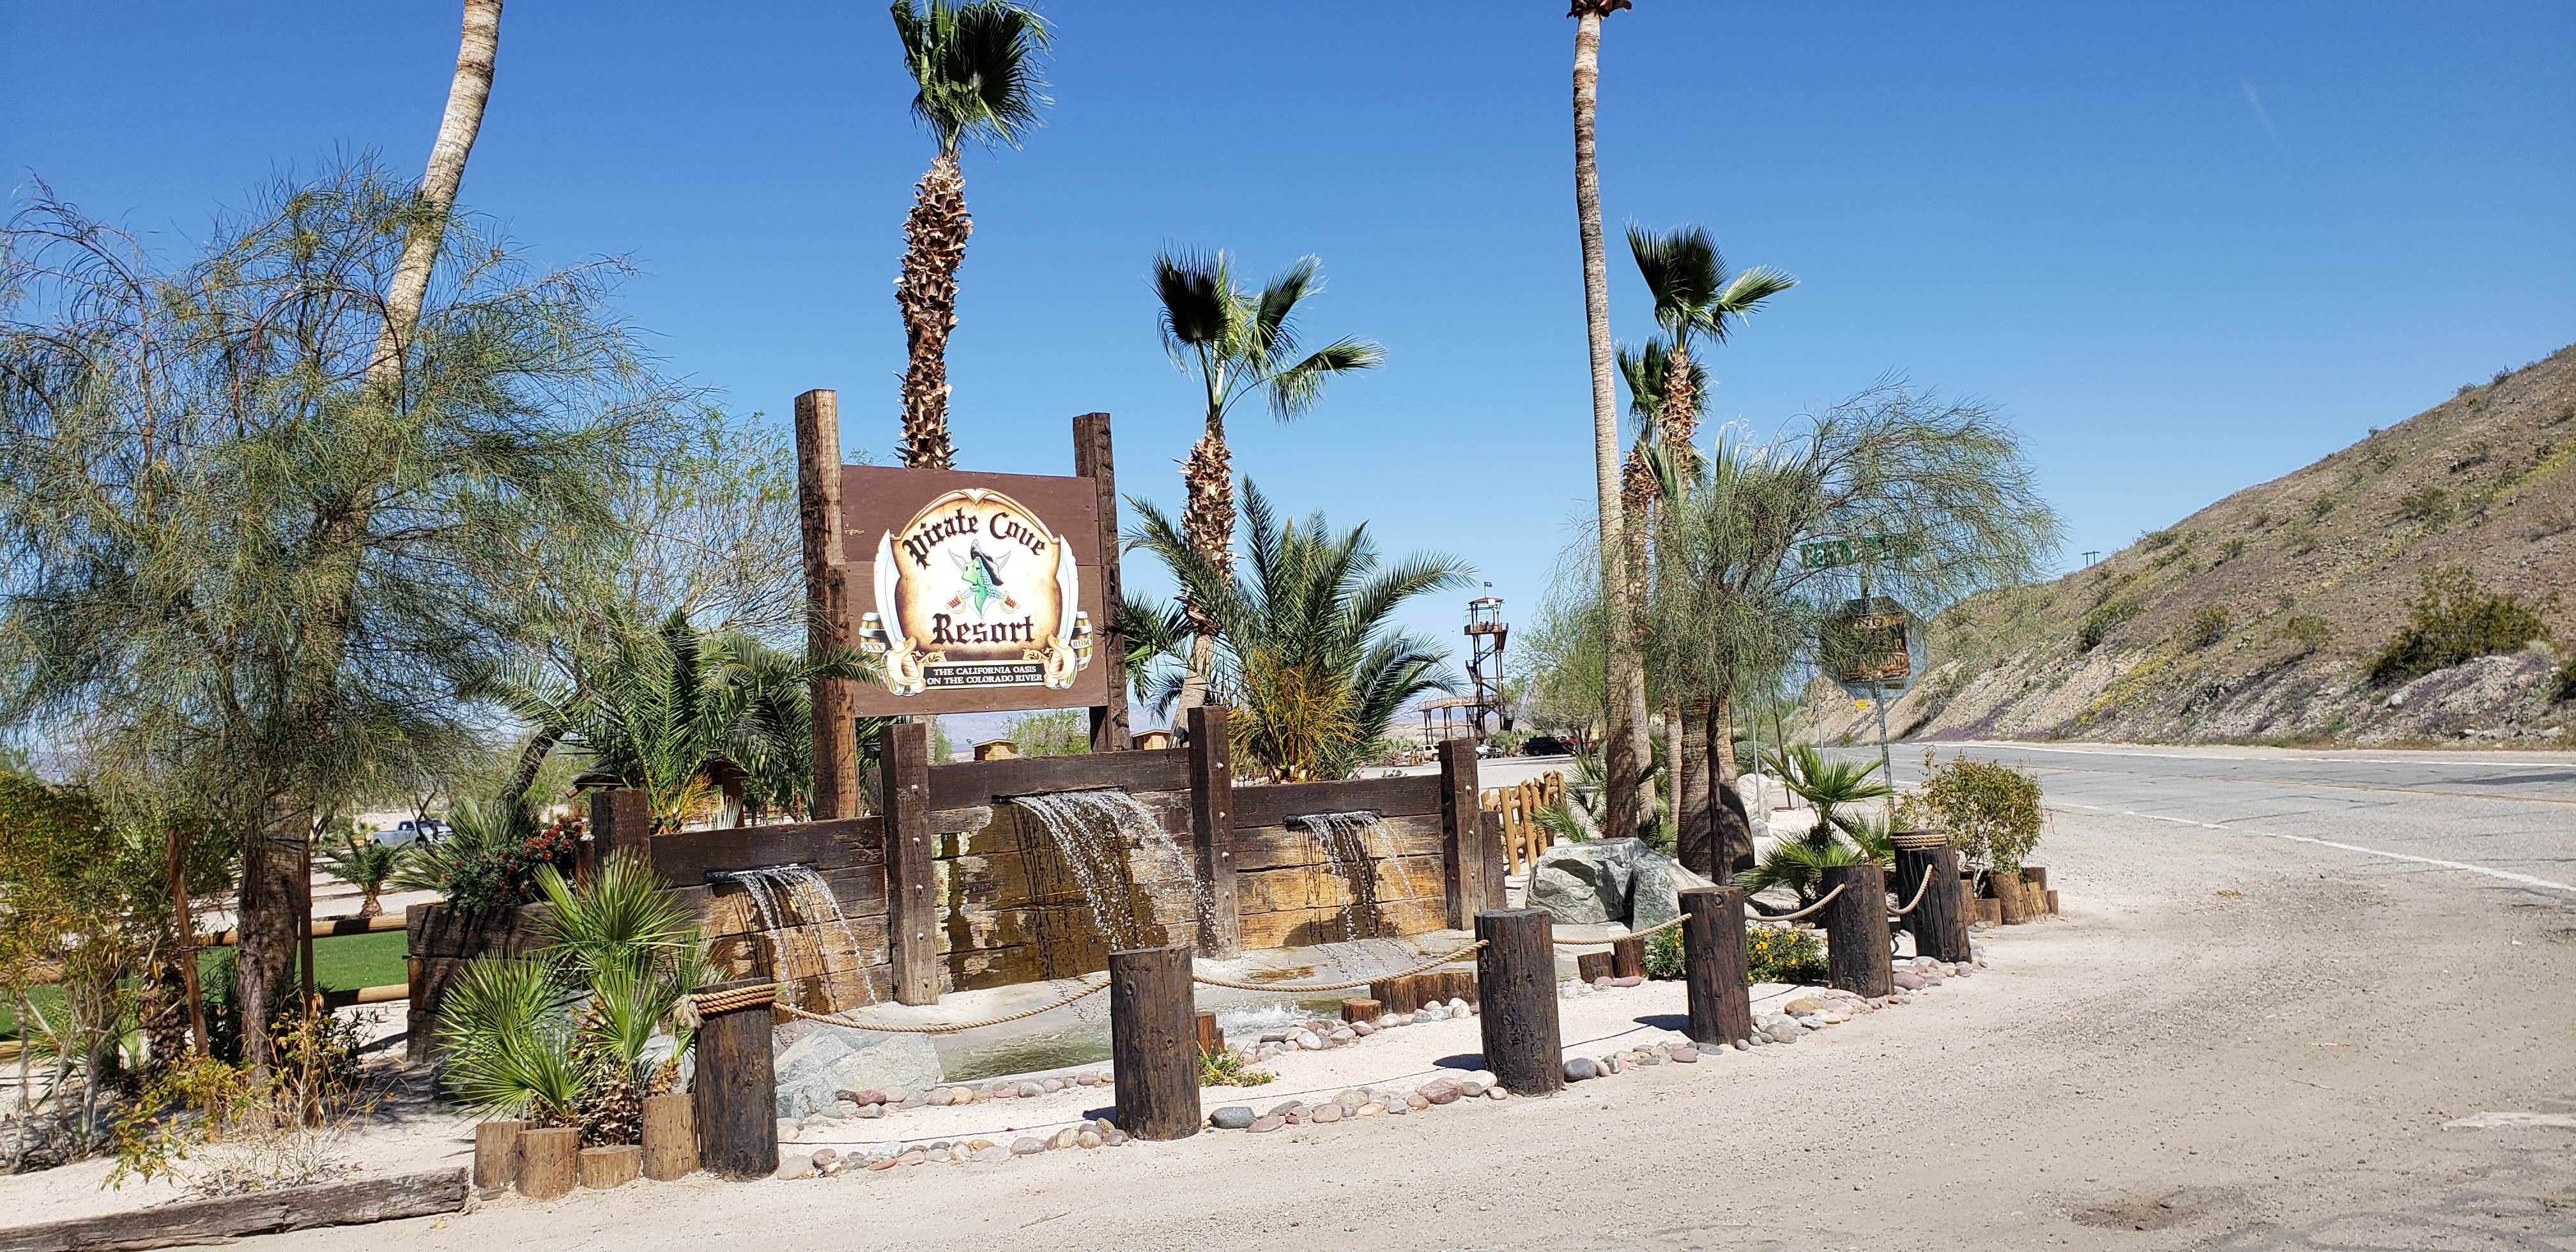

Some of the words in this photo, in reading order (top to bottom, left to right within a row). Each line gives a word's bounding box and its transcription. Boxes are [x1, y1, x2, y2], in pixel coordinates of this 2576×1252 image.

[902, 507, 979, 570] Pirate
[990, 512, 1046, 556] Cove
[930, 613, 1037, 645] Resort
[1073, 639, 1090, 648] RUM
[956, 666, 1011, 675] CALIFORNIA
[927, 677, 941, 685] ON
[966, 675, 1014, 683] COLORADO
[1015, 673, 1043, 682] RIVER
